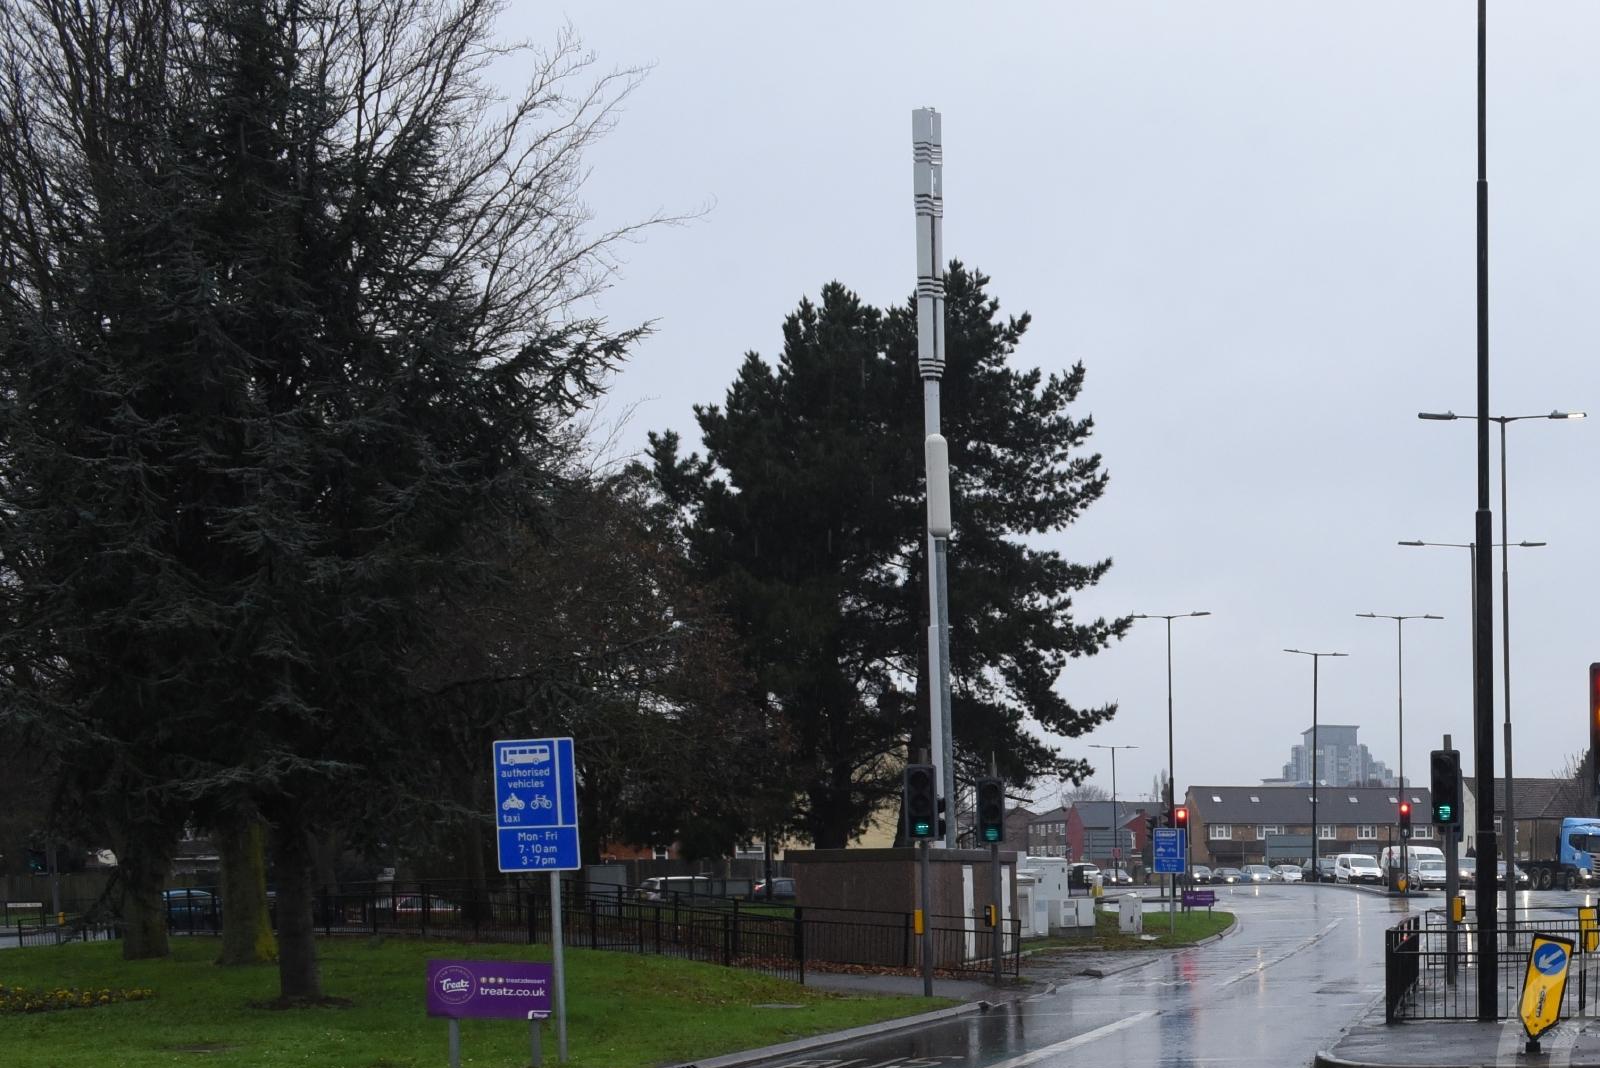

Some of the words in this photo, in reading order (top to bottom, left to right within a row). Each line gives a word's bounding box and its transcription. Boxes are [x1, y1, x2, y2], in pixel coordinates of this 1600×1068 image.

[501, 767, 550, 778] authorised
[507, 779, 545, 789] vehicles
[503, 813, 521, 823] taxi
[545, 831, 558, 840] Fri
[439, 978, 470, 992] Treatz
[480, 987, 546, 997] treatz.co.uk
